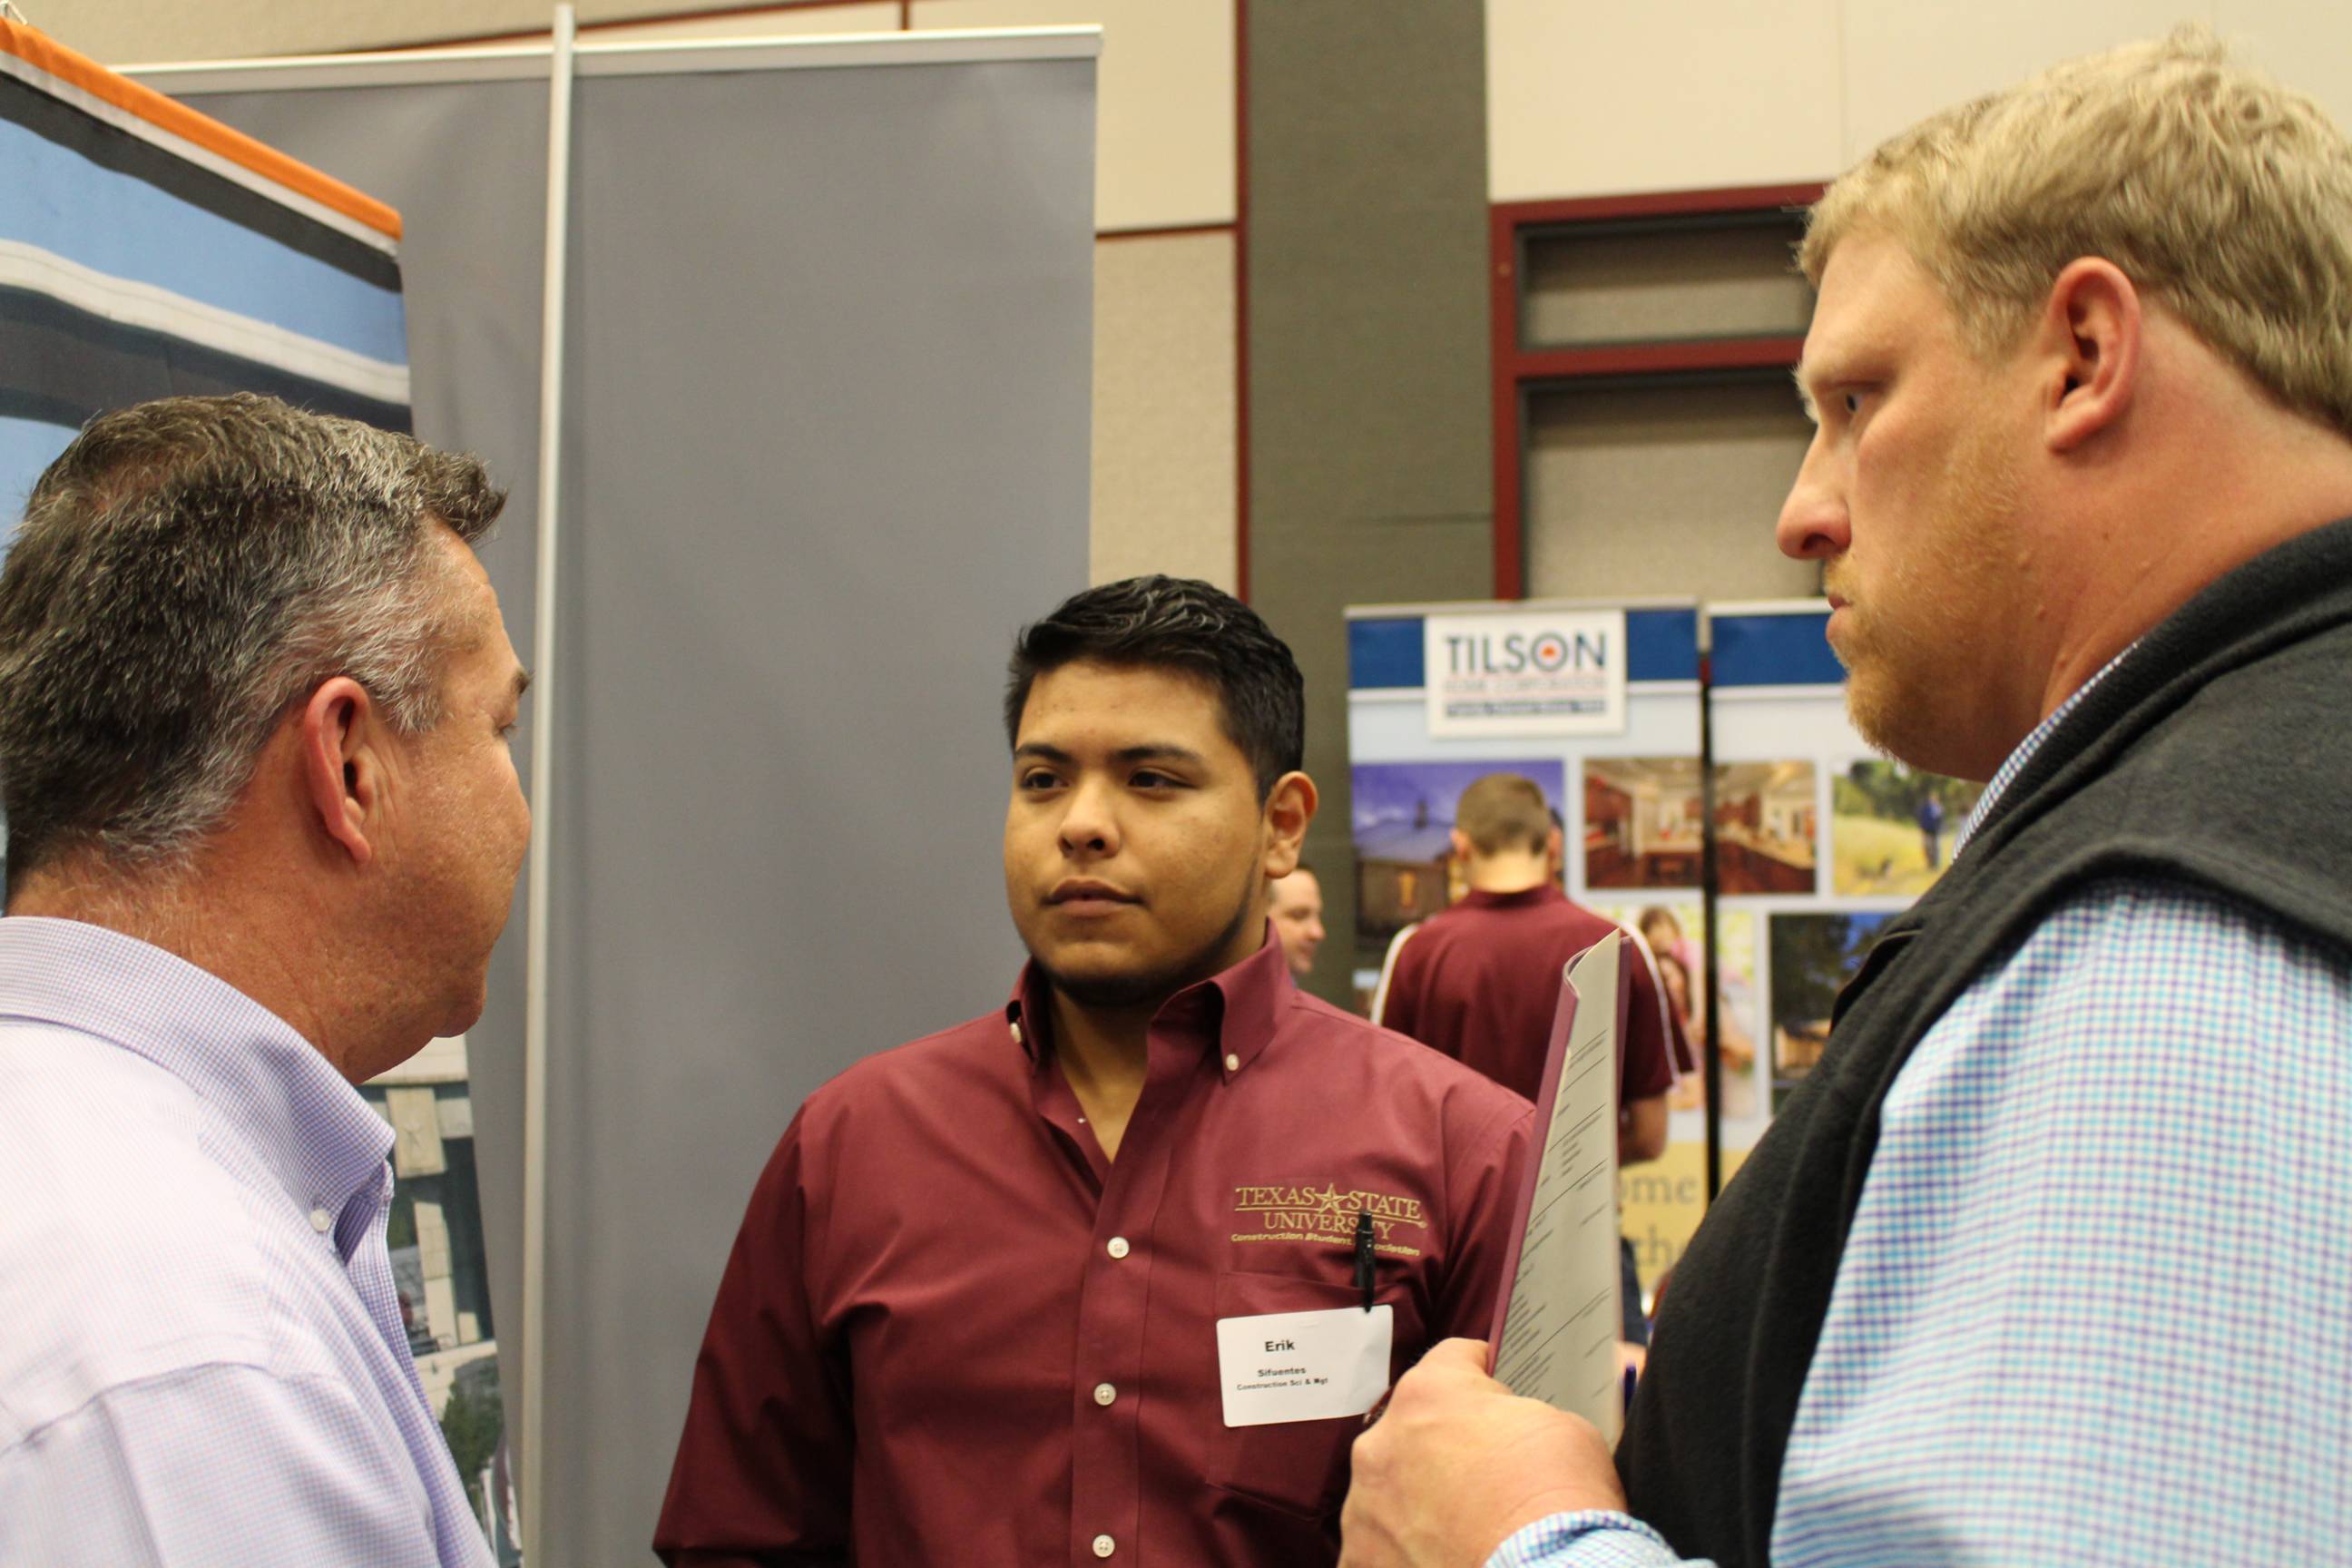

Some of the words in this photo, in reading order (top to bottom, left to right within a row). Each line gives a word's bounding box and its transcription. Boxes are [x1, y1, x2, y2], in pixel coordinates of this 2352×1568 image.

[1446, 632, 1606, 672] TILSON
[1235, 1187, 1315, 1206] TEXAS
[1348, 1191, 1421, 1220] STATE
[1264, 1211, 1395, 1240] UNIVERSY
[1231, 1232, 1304, 1242] Construction
[1264, 1339, 1296, 1353] Erik
[1258, 1367, 1307, 1377] Sifuentes
[1237, 1380, 1288, 1391] Construction
[1289, 1378, 1303, 1387] Sci
